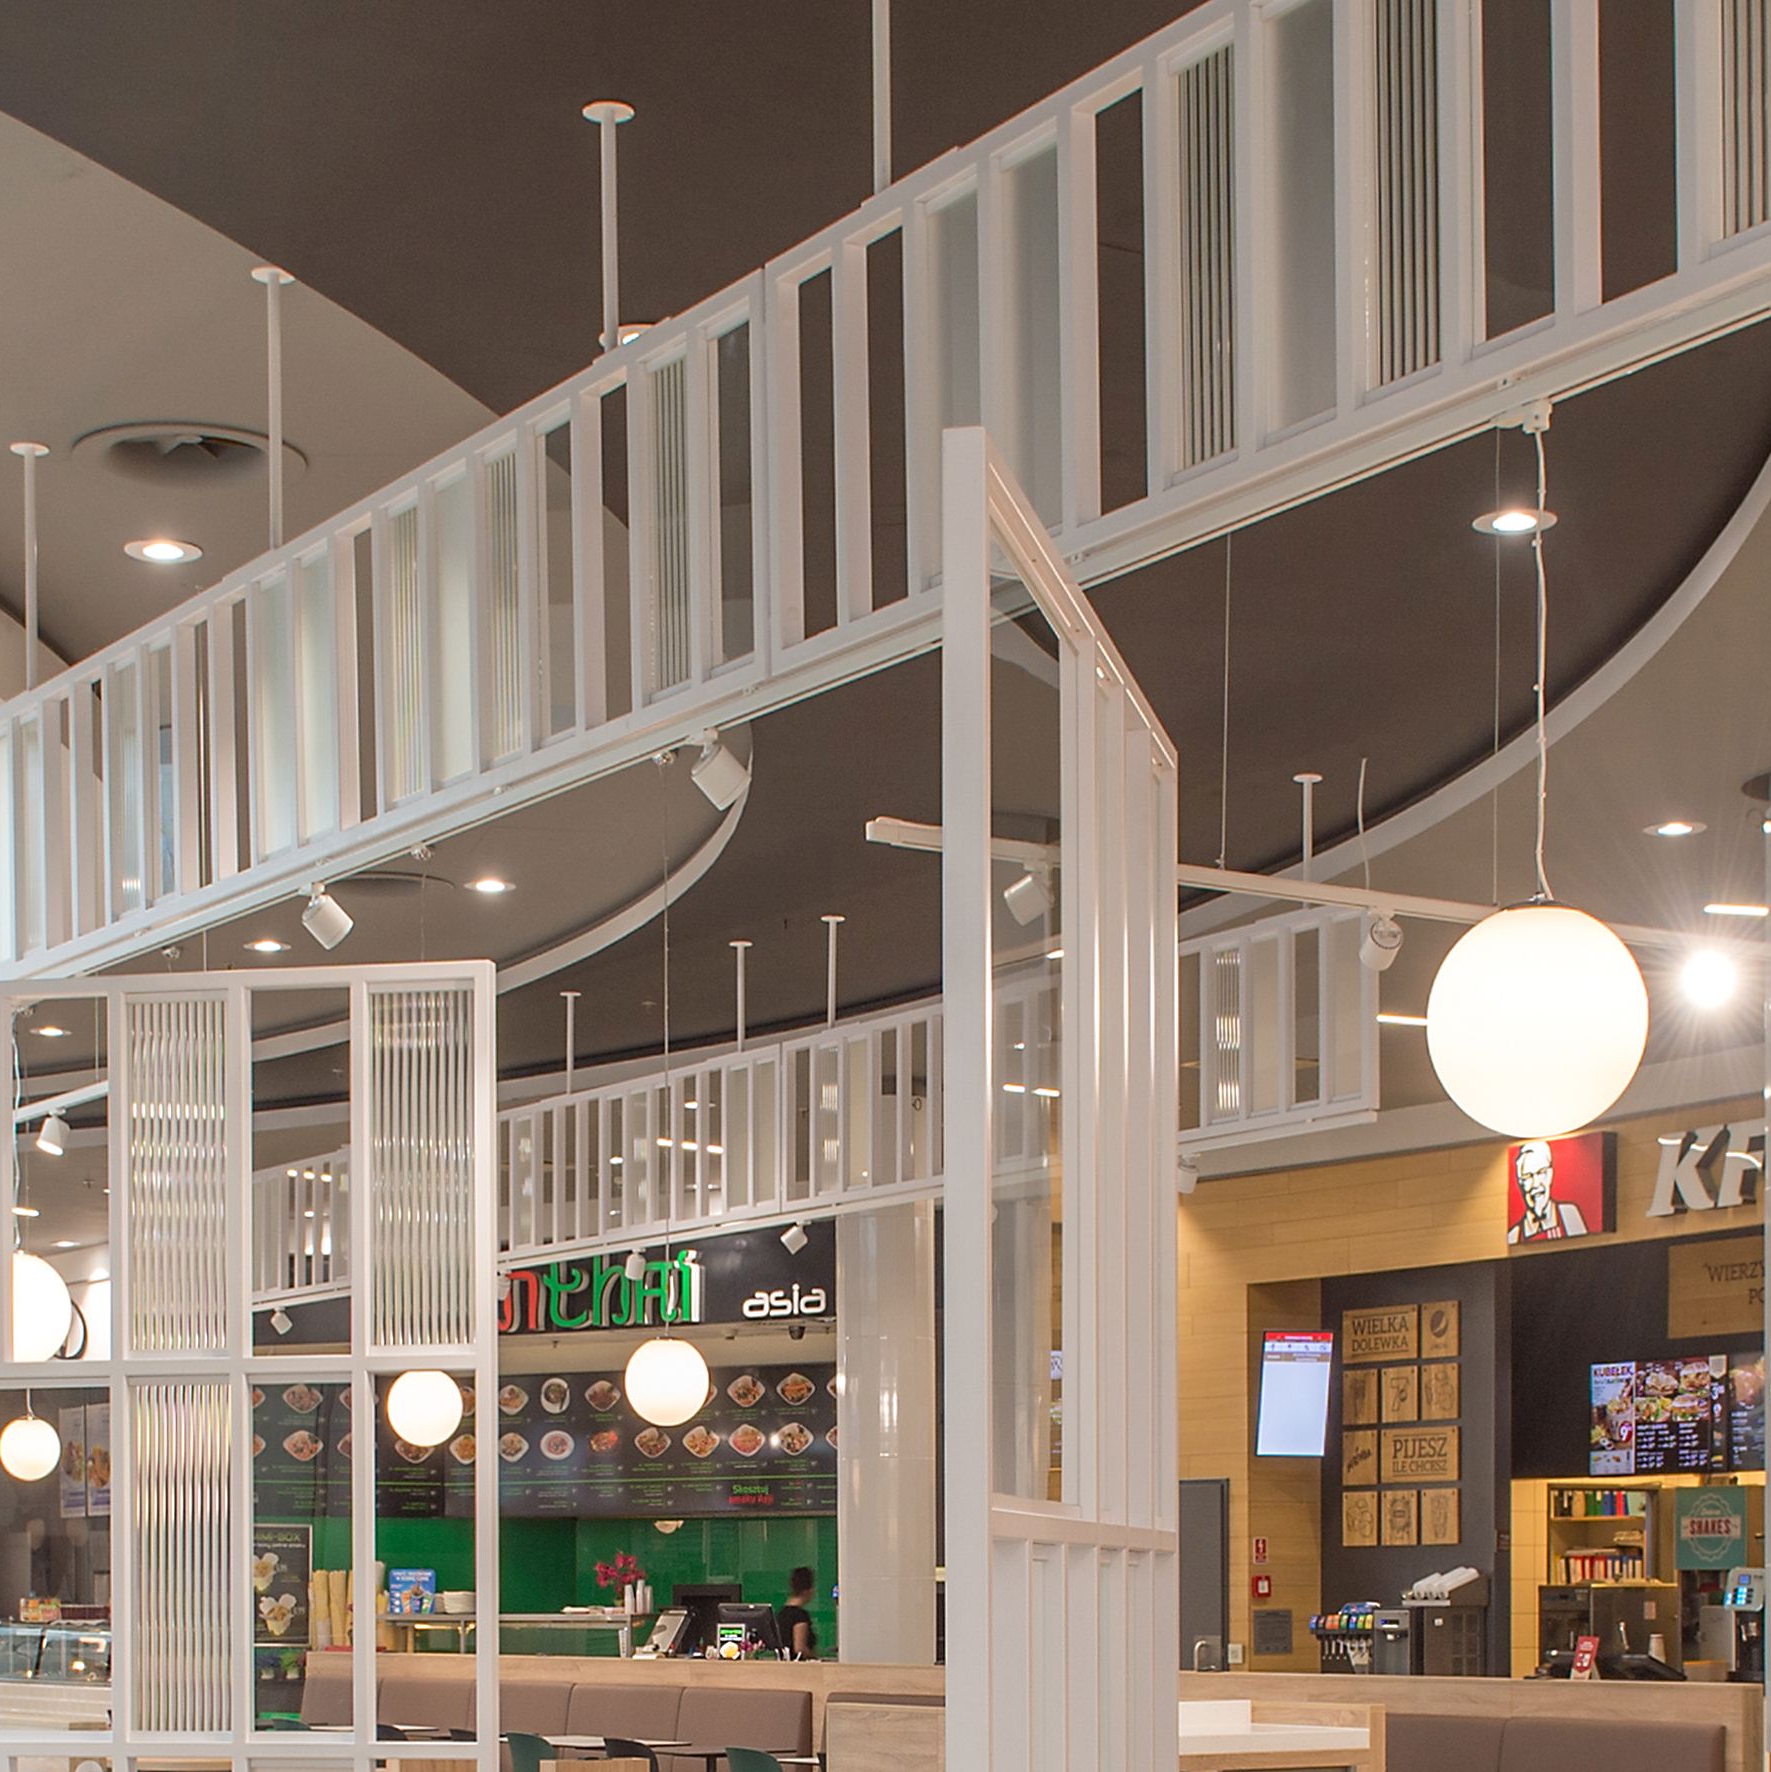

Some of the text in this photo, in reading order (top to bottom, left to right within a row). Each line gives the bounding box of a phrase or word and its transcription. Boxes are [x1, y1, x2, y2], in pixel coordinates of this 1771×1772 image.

[1645, 1118, 1766, 1217] KF
[742, 1283, 826, 1318] asia
[1352, 1316, 1409, 1336] WIELKA
[1352, 1335, 1408, 1352] DOLEWKA
[1392, 1436, 1448, 1459] PIJESZ
[1392, 1459, 1448, 1474] ILE CHCESZ
